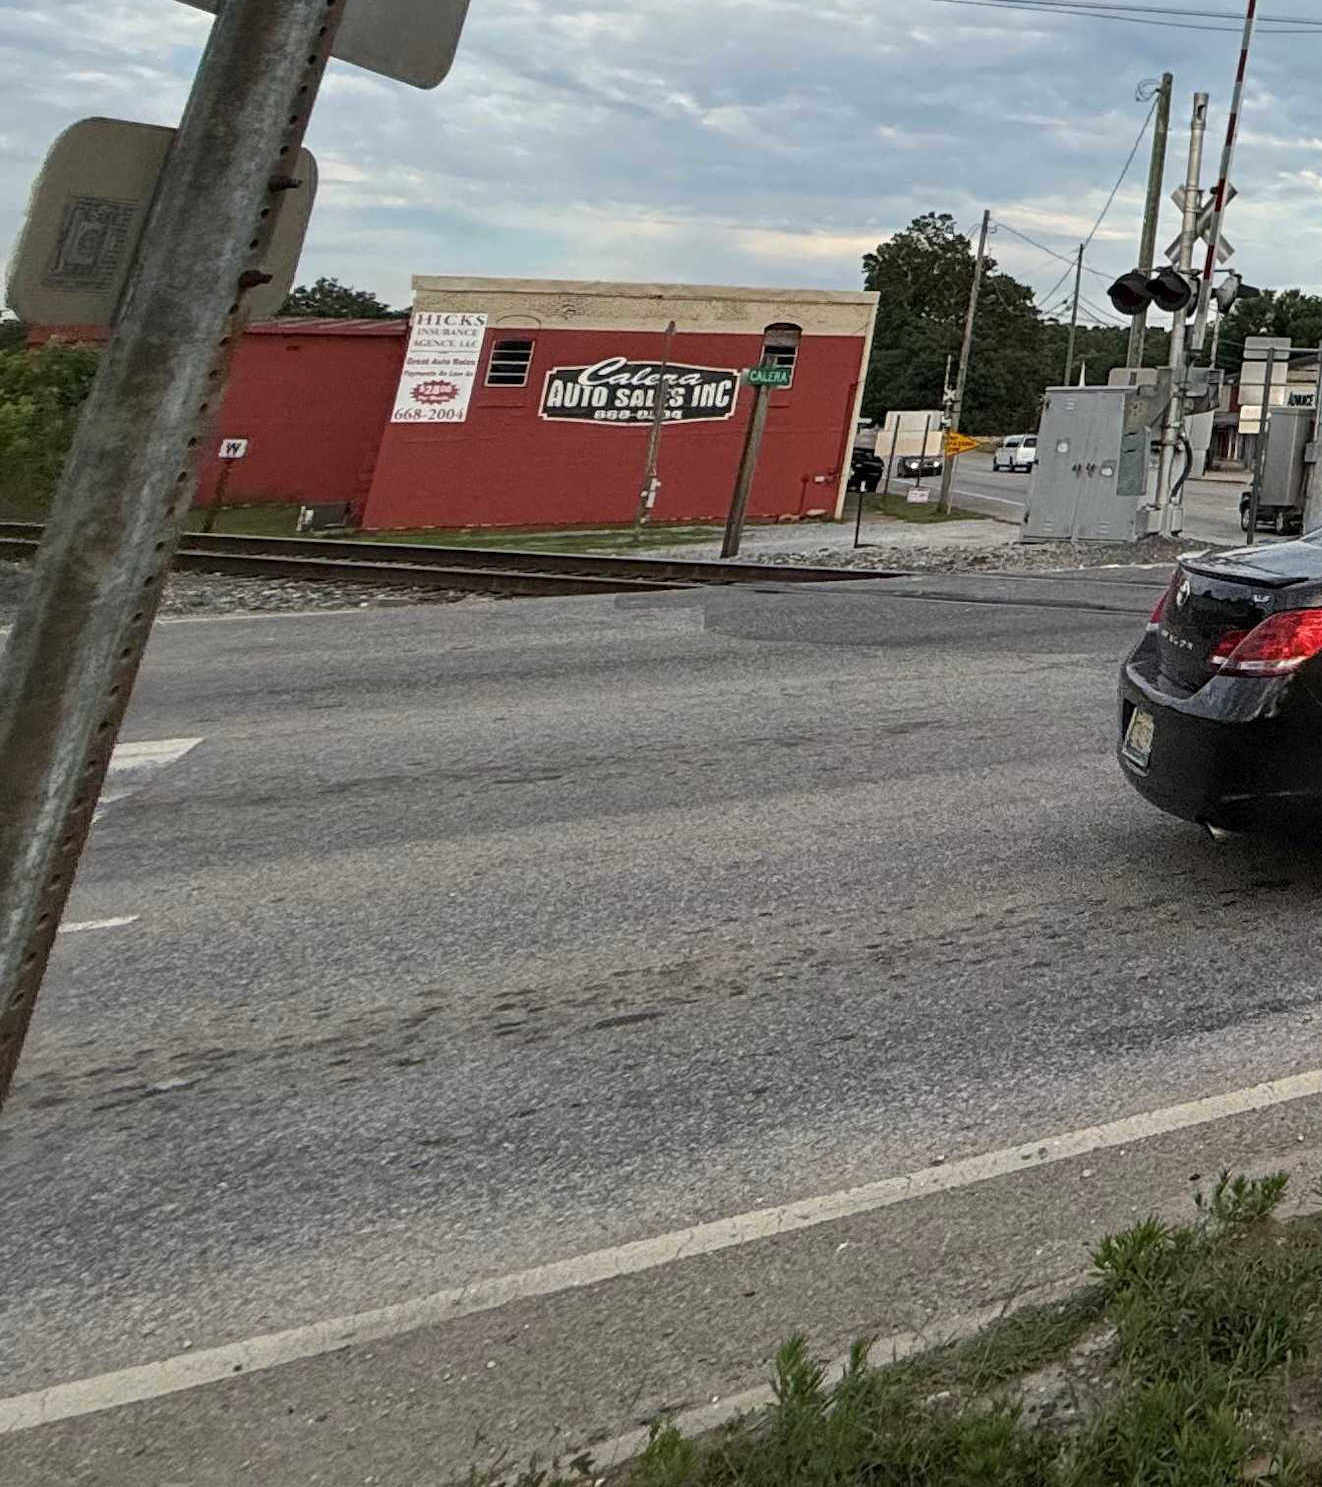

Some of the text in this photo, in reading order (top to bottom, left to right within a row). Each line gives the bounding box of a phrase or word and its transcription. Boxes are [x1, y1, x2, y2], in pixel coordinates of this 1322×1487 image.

[417, 314, 486, 326] HICKS
[577, 356, 703, 386] Calera
[750, 370, 789, 384] CALERA
[546, 379, 609, 408] AUTO
[691, 380, 733, 408] INC
[394, 408, 464, 421] 668-2004
[226, 441, 242, 456] W
